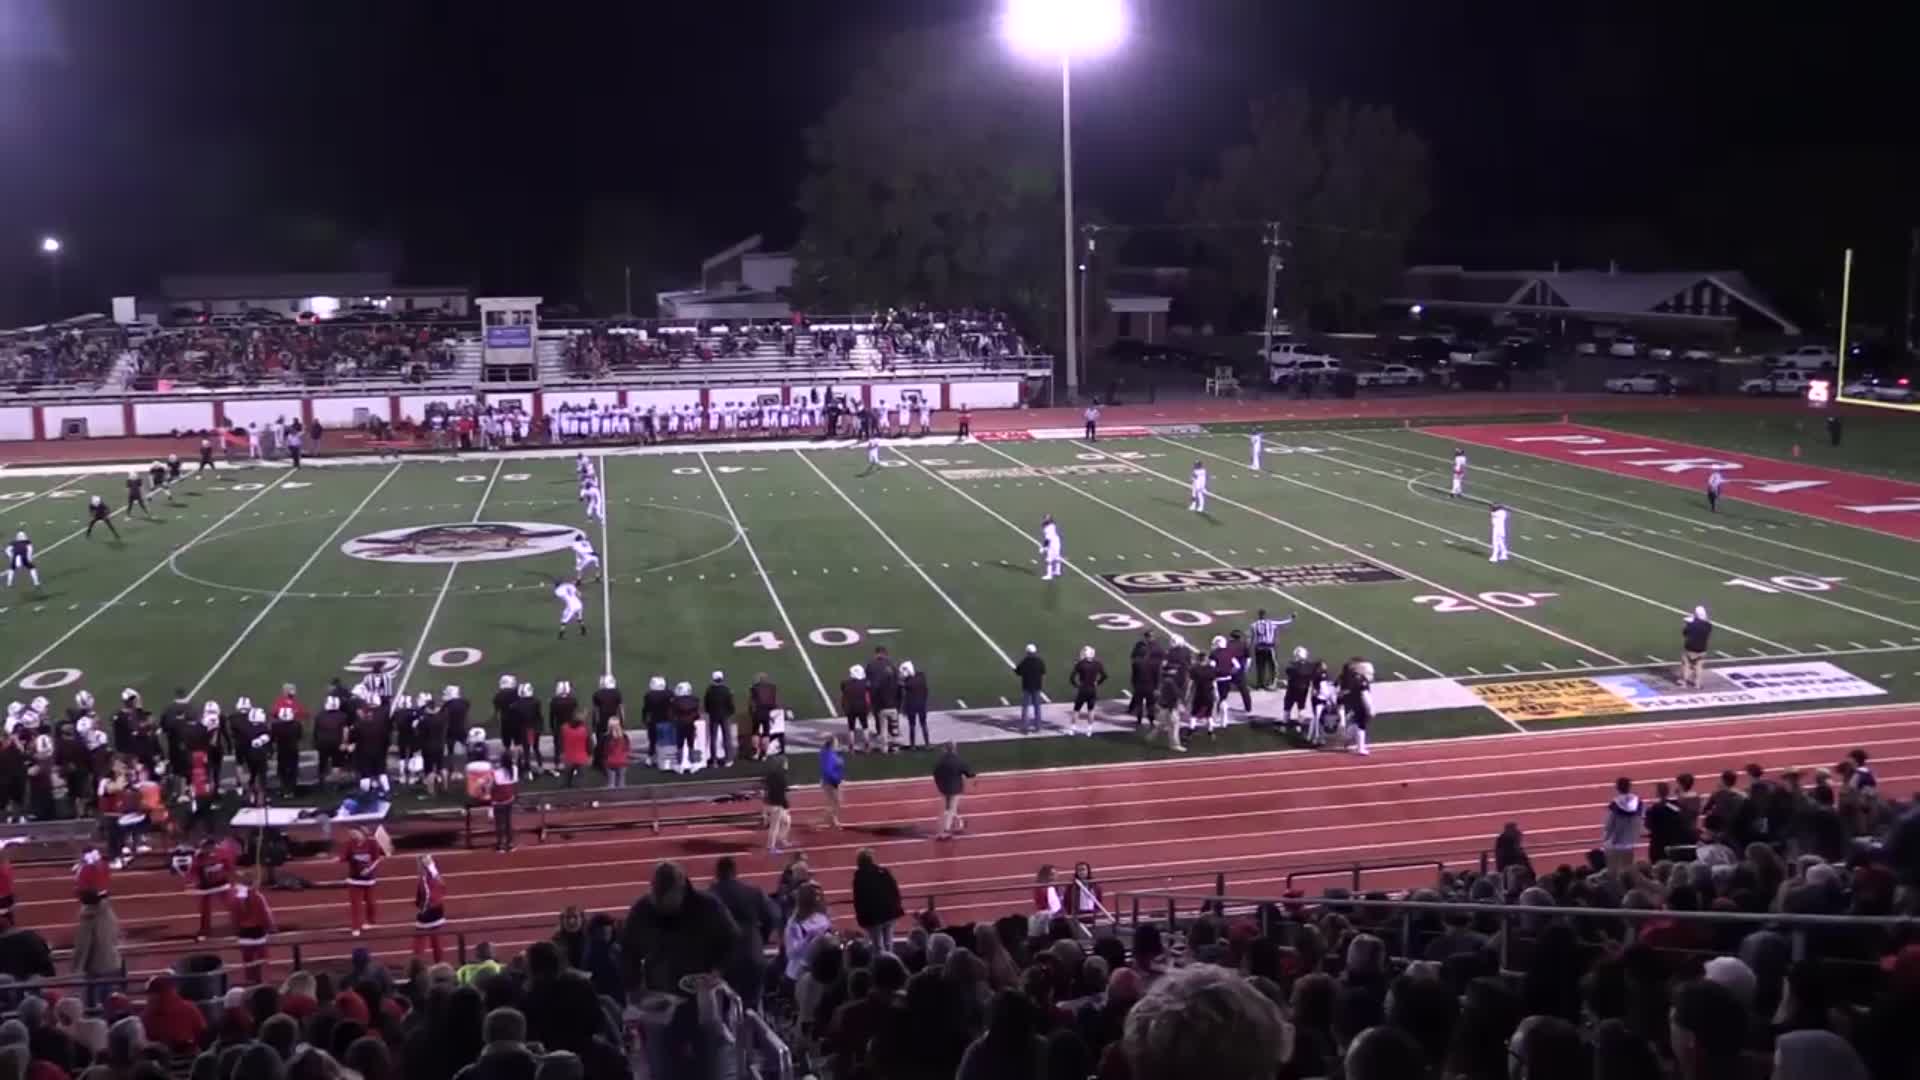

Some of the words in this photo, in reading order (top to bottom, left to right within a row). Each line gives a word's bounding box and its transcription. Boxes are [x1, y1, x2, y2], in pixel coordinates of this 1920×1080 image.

[1722, 575, 1831, 593] 10
[1412, 591, 1536, 612] 20
[1089, 609, 1214, 631] 30
[733, 627, 861, 649] 40
[344, 647, 483, 677] 50
[1476, 679, 1599, 695] JENSEN'S
